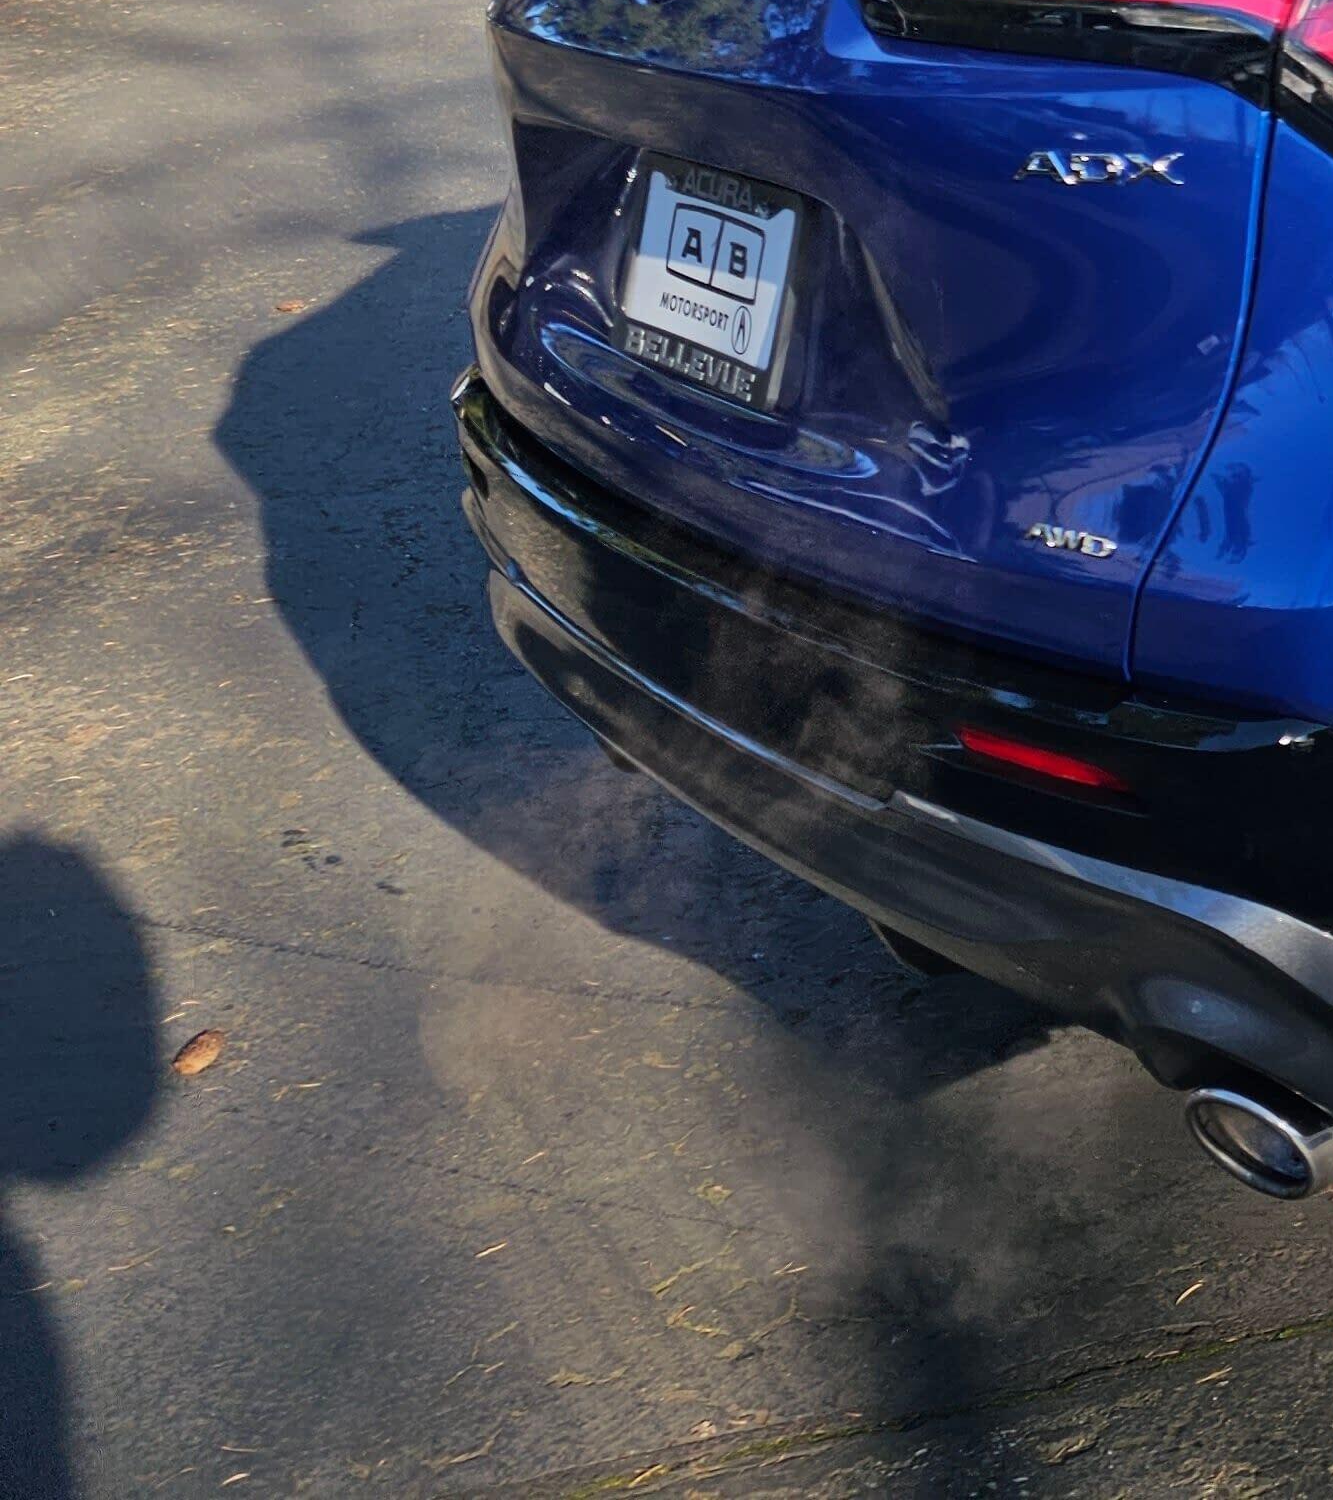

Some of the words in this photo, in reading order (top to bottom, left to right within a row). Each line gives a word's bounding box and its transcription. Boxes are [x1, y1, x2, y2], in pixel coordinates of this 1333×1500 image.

[683, 166, 754, 213] ACURA
[1013, 150, 1185, 185] ADX
[681, 226, 703, 264] A
[728, 240, 749, 280] B
[659, 291, 730, 332] MOTORSPORT
[625, 325, 757, 402] BELLEVUE
[1024, 522, 1118, 558] AWD
